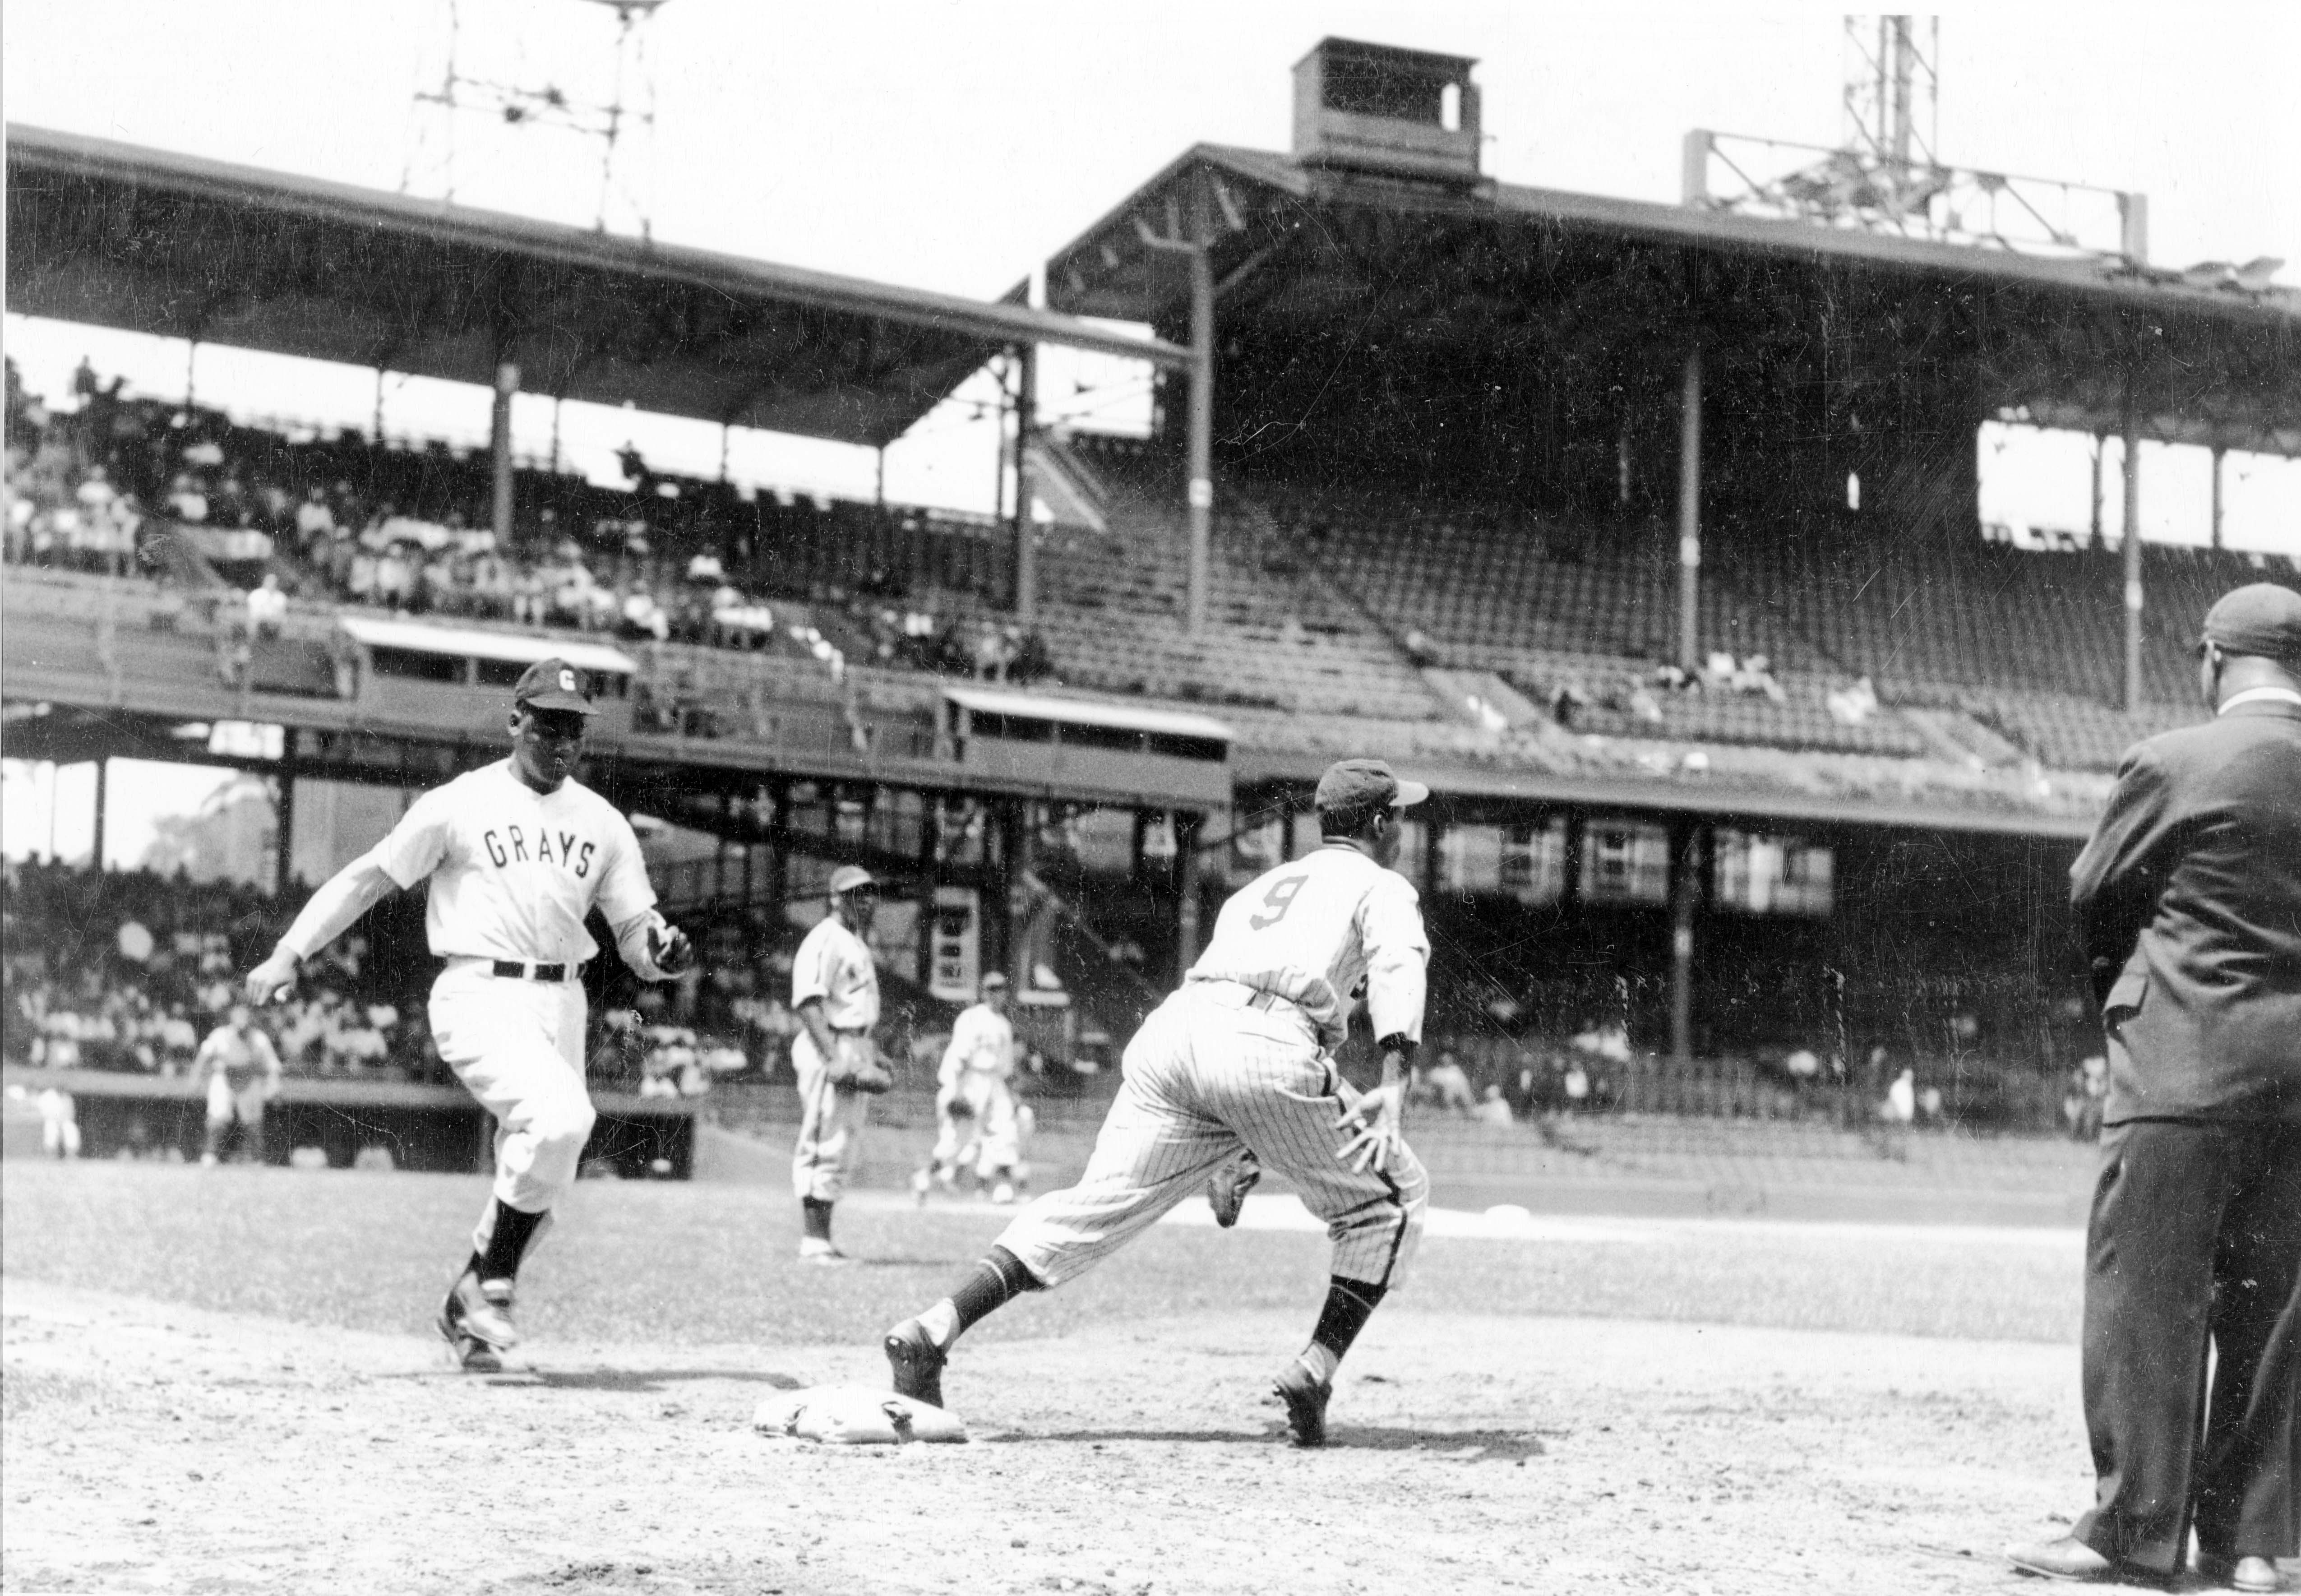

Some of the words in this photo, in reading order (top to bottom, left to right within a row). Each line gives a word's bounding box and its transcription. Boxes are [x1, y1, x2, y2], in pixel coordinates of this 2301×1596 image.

[559, 670, 575, 690] G
[484, 824, 595, 878] GRAYS
[1249, 874, 1308, 931] 9
